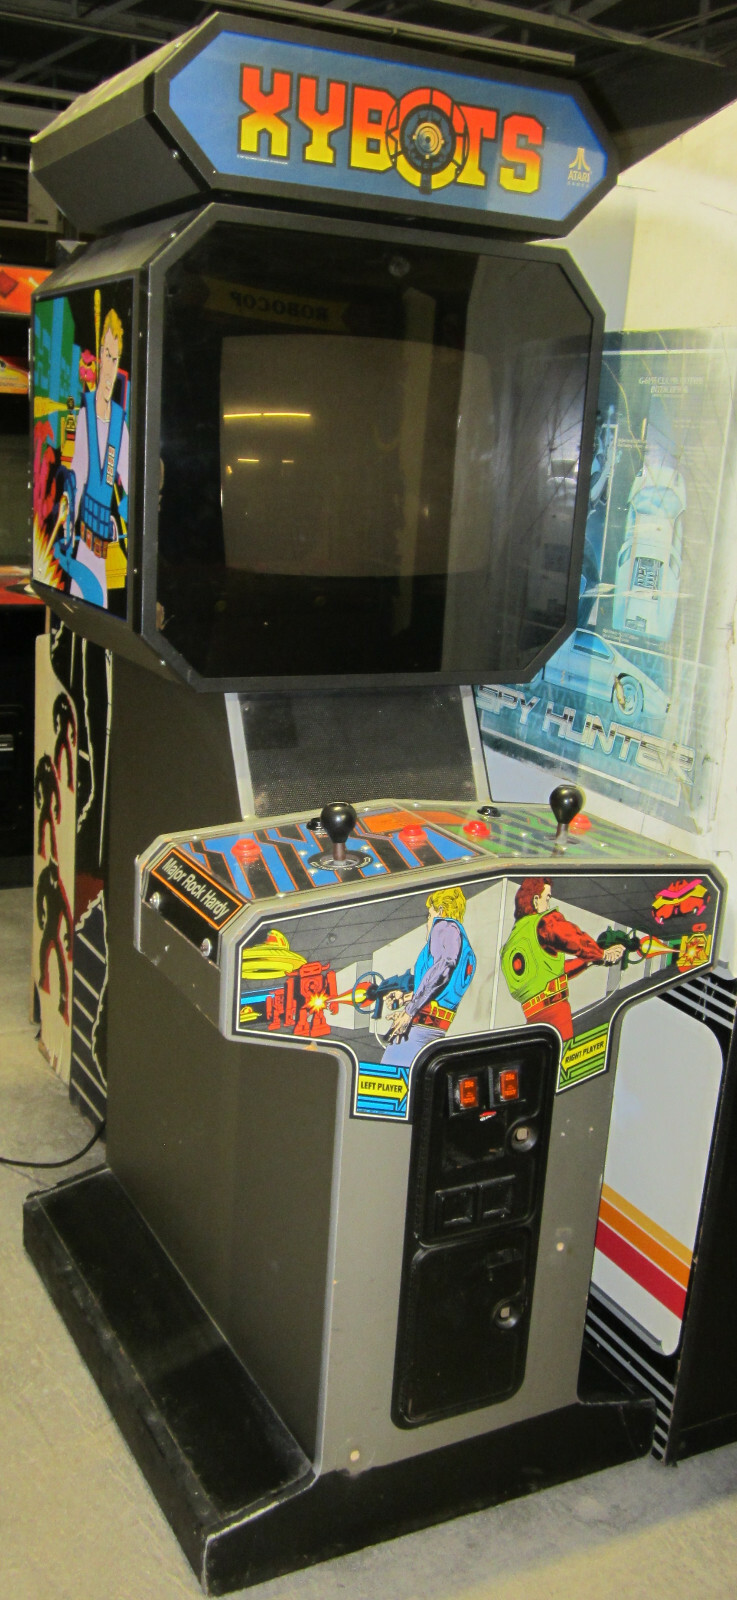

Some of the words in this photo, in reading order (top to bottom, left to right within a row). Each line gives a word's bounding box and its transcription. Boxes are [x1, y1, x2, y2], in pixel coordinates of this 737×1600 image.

[238, 62, 545, 195] XYBOTS
[567, 170, 590, 183] ATARI
[475, 684, 540, 725] SPY
[542, 701, 697, 785] HUNTER
[161, 857, 187, 882] Major
[181, 873, 207, 899] Rock
[200, 889, 230, 920] Hardy
[565, 1050, 582, 1064] RIGHT
[582, 1041, 604, 1056] PLAYER
[360, 1081, 376, 1090] LEFT
[377, 1083, 403, 1093] PLAYER
